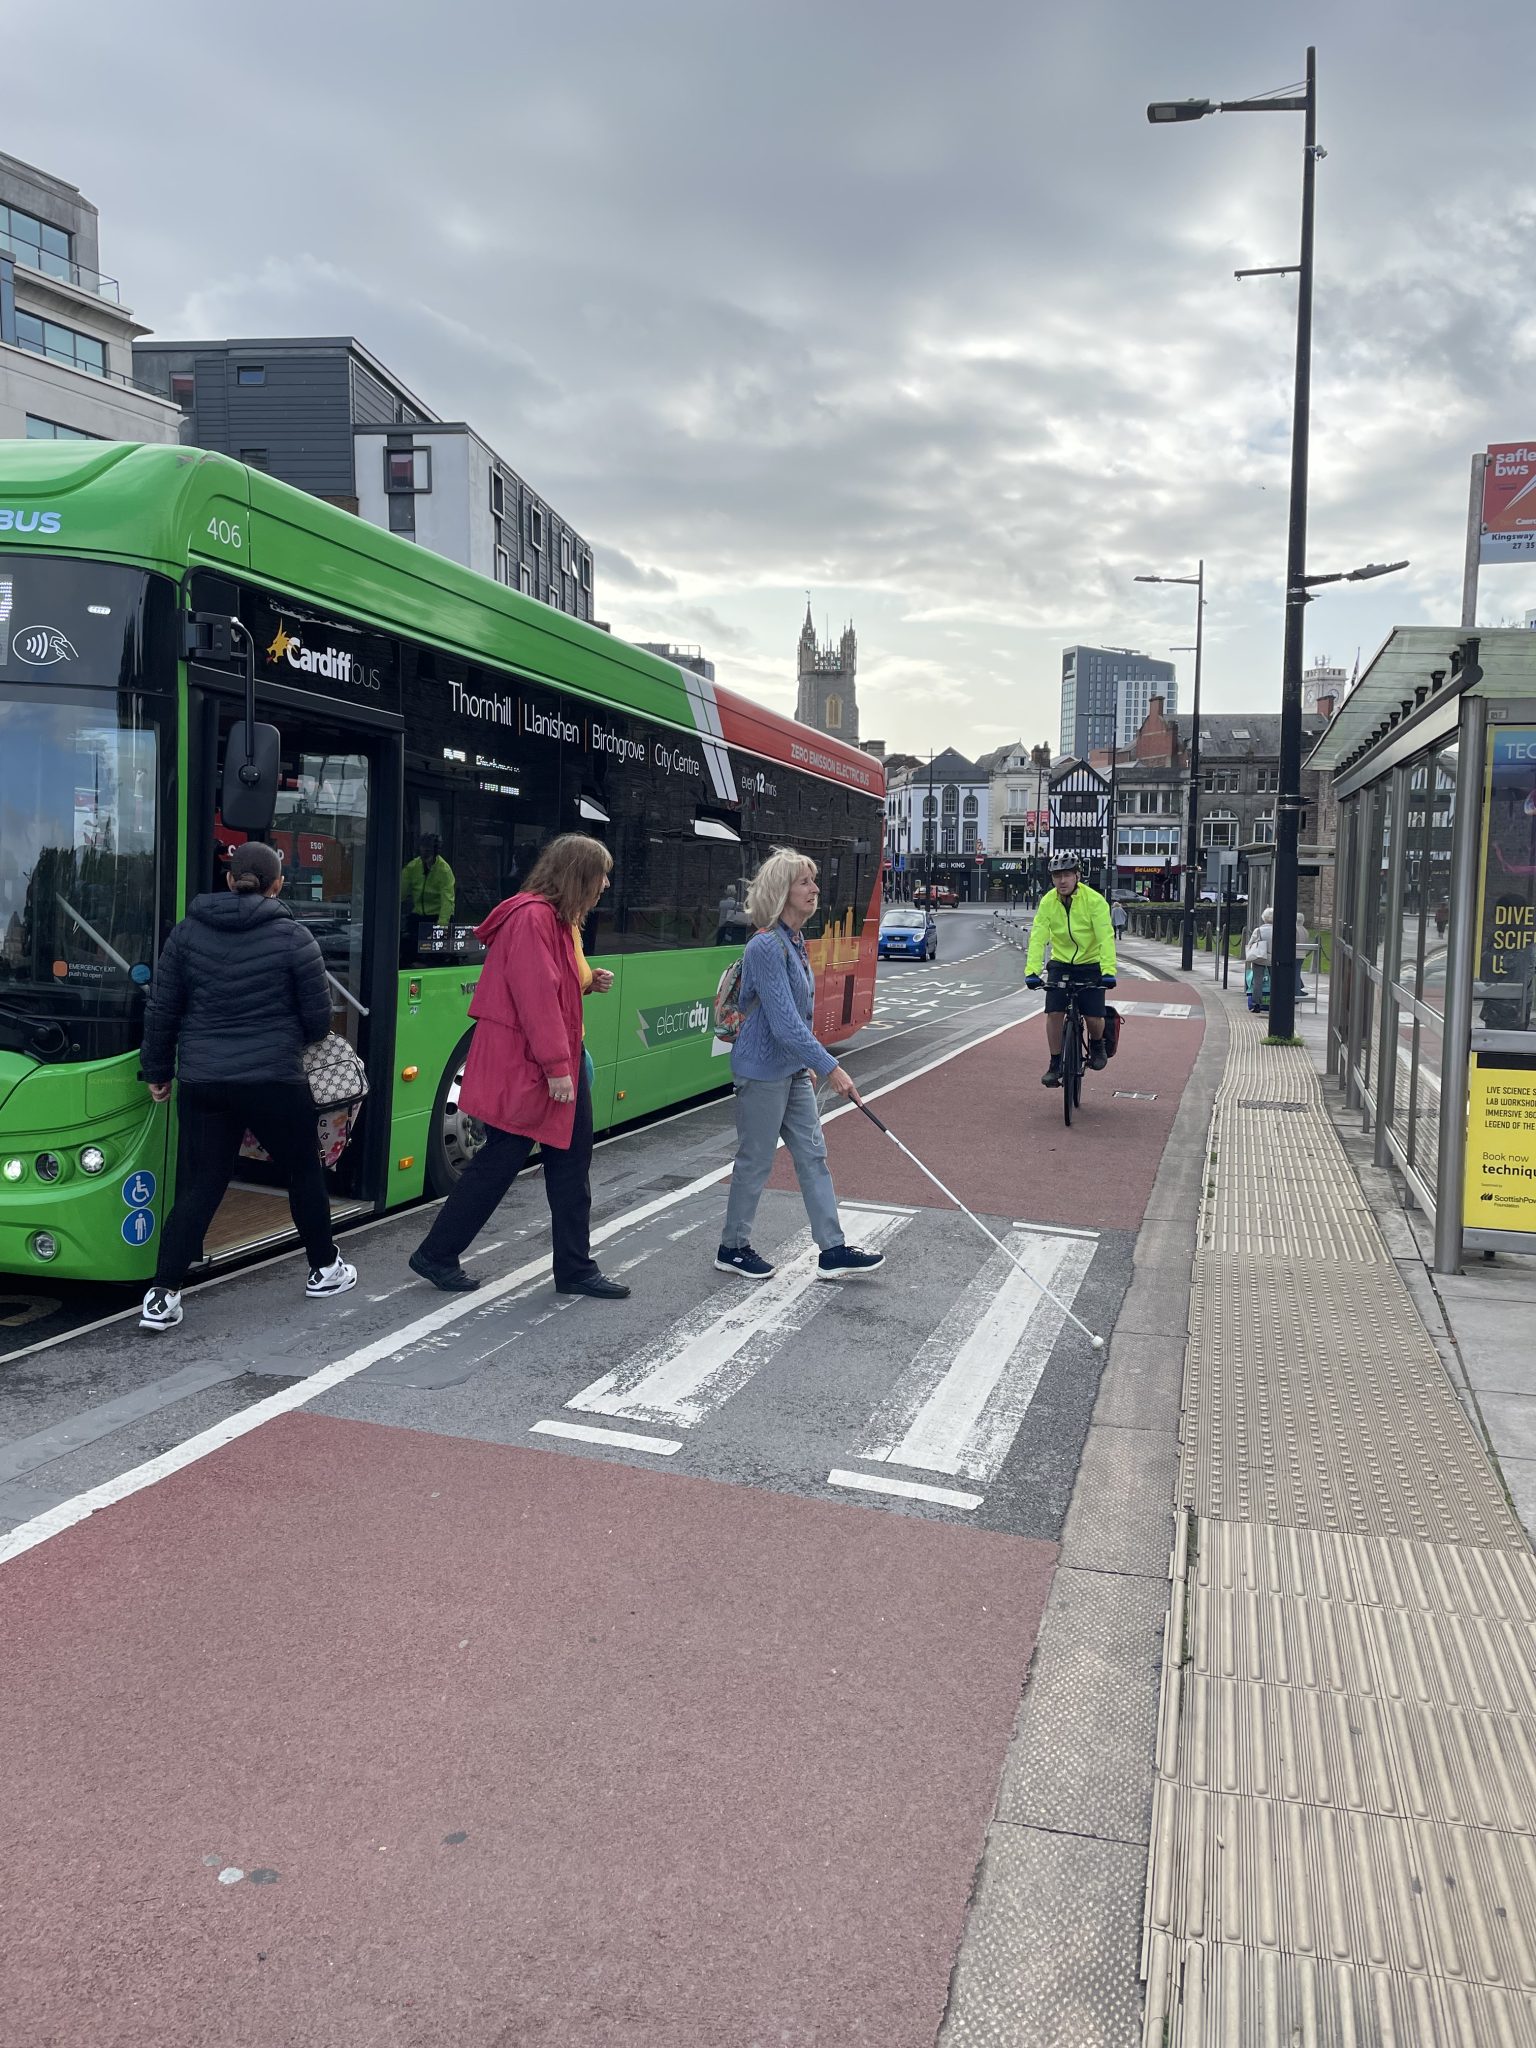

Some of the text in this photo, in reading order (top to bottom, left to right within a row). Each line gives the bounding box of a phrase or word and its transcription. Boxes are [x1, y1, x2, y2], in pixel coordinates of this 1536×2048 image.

[1495, 464, 1529, 477] bws
[207, 517, 242, 548] 406
[1491, 533, 1534, 542] Kingsway
[448, 680, 700, 777] Thornhill Llanishen Birchgrove City Centre
[790, 743, 870, 786] ZERO EMISSION ELECTRIC BUS
[741, 771, 777, 797] every 12 mins
[1495, 905, 1535, 925] DIVE
[68, 962, 117, 973] EMERGENCY EXIT
[656, 1000, 710, 1036] electricity
[1486, 1086, 1501, 1094] LIVE
[1502, 1086, 1531, 1095] SCIENCE
[1486, 1097, 1536, 1107] LAB WORKSHO
[1485, 1109, 1522, 1118] IMMERSIVE
[1484, 1120, 1535, 1131] LEGEND OF THE
[1482, 1151, 1506, 1161] Book
